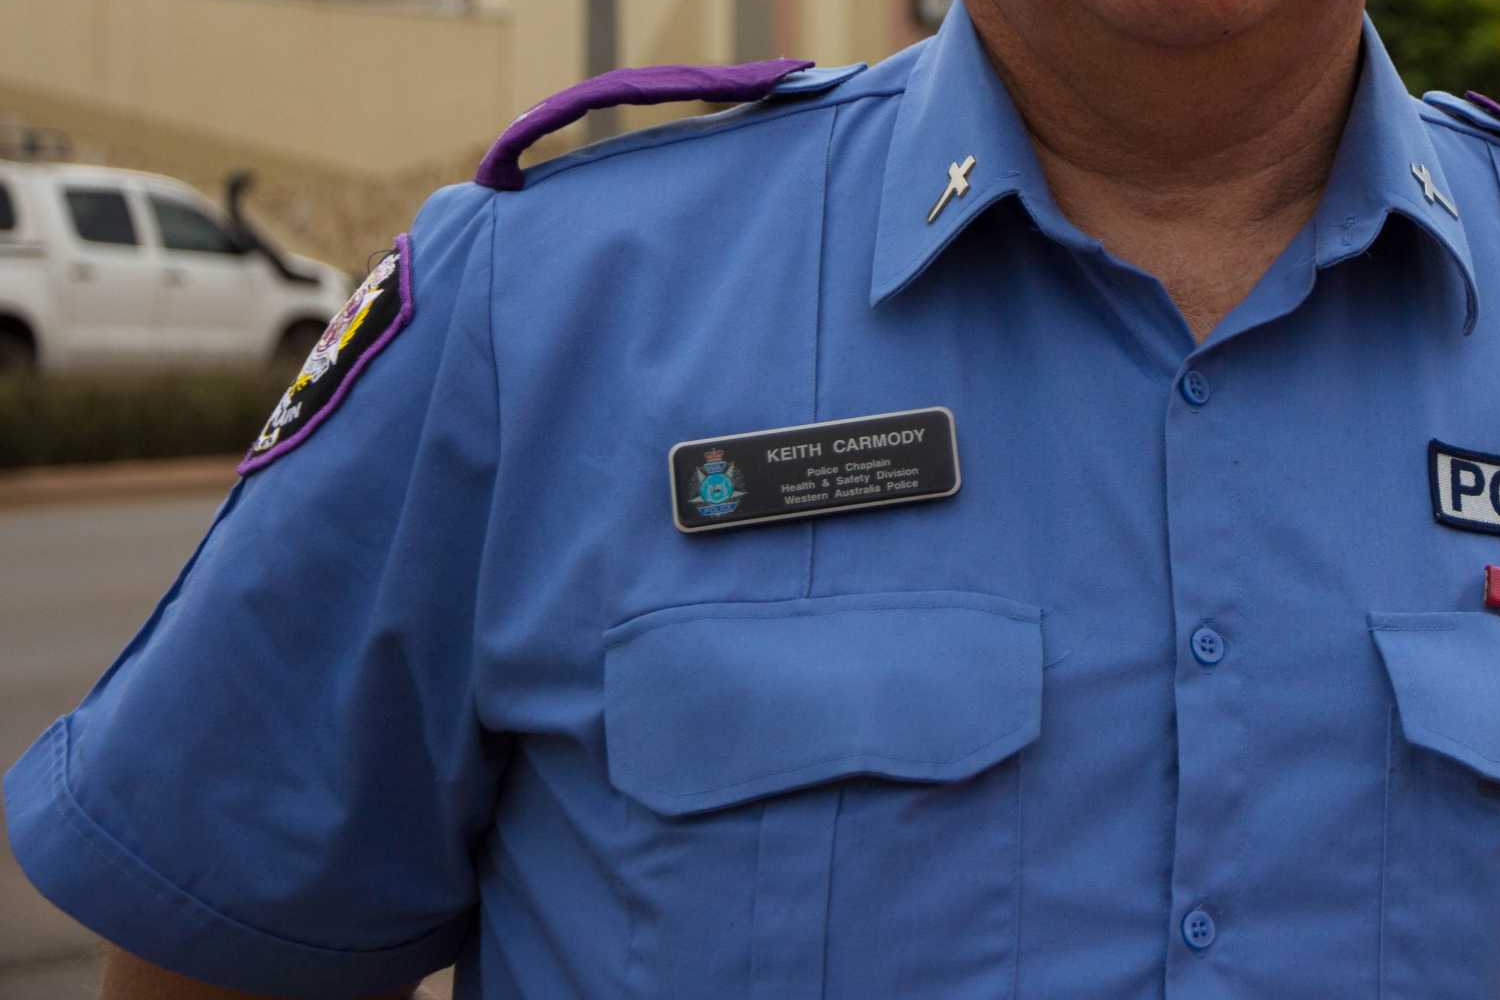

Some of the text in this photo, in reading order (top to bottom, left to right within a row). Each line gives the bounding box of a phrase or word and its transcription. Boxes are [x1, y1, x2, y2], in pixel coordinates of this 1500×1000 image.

[767, 428, 925, 463] KEITH CARMODY
[781, 467, 919, 493] Health & Safety Division
[807, 458, 891, 477] Police Chaplain
[784, 479, 919, 505] Western Australia Police
